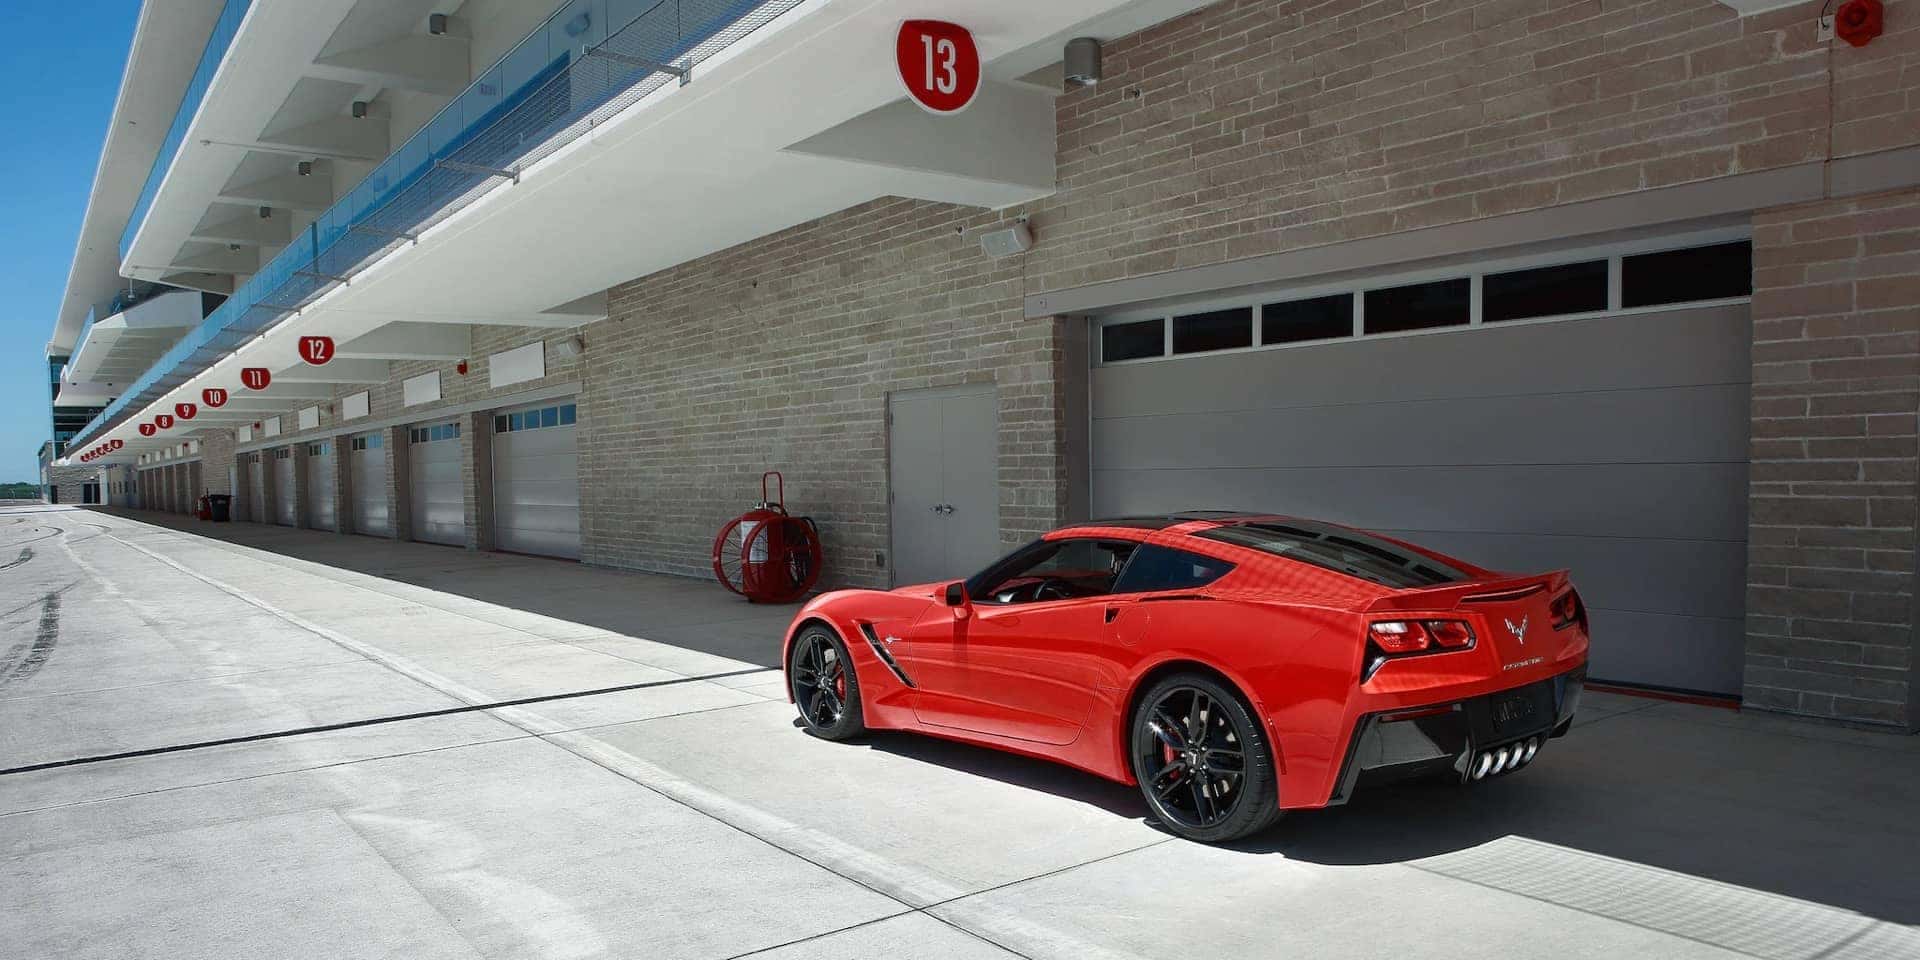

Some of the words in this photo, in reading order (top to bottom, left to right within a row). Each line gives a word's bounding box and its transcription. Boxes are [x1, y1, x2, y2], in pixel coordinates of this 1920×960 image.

[921, 34, 957, 94] 13
[308, 340, 325, 359] 12
[250, 371, 262, 386] 11
[208, 391, 221, 404] 10
[184, 405, 190, 416] 9
[145, 425, 151, 434] 7
